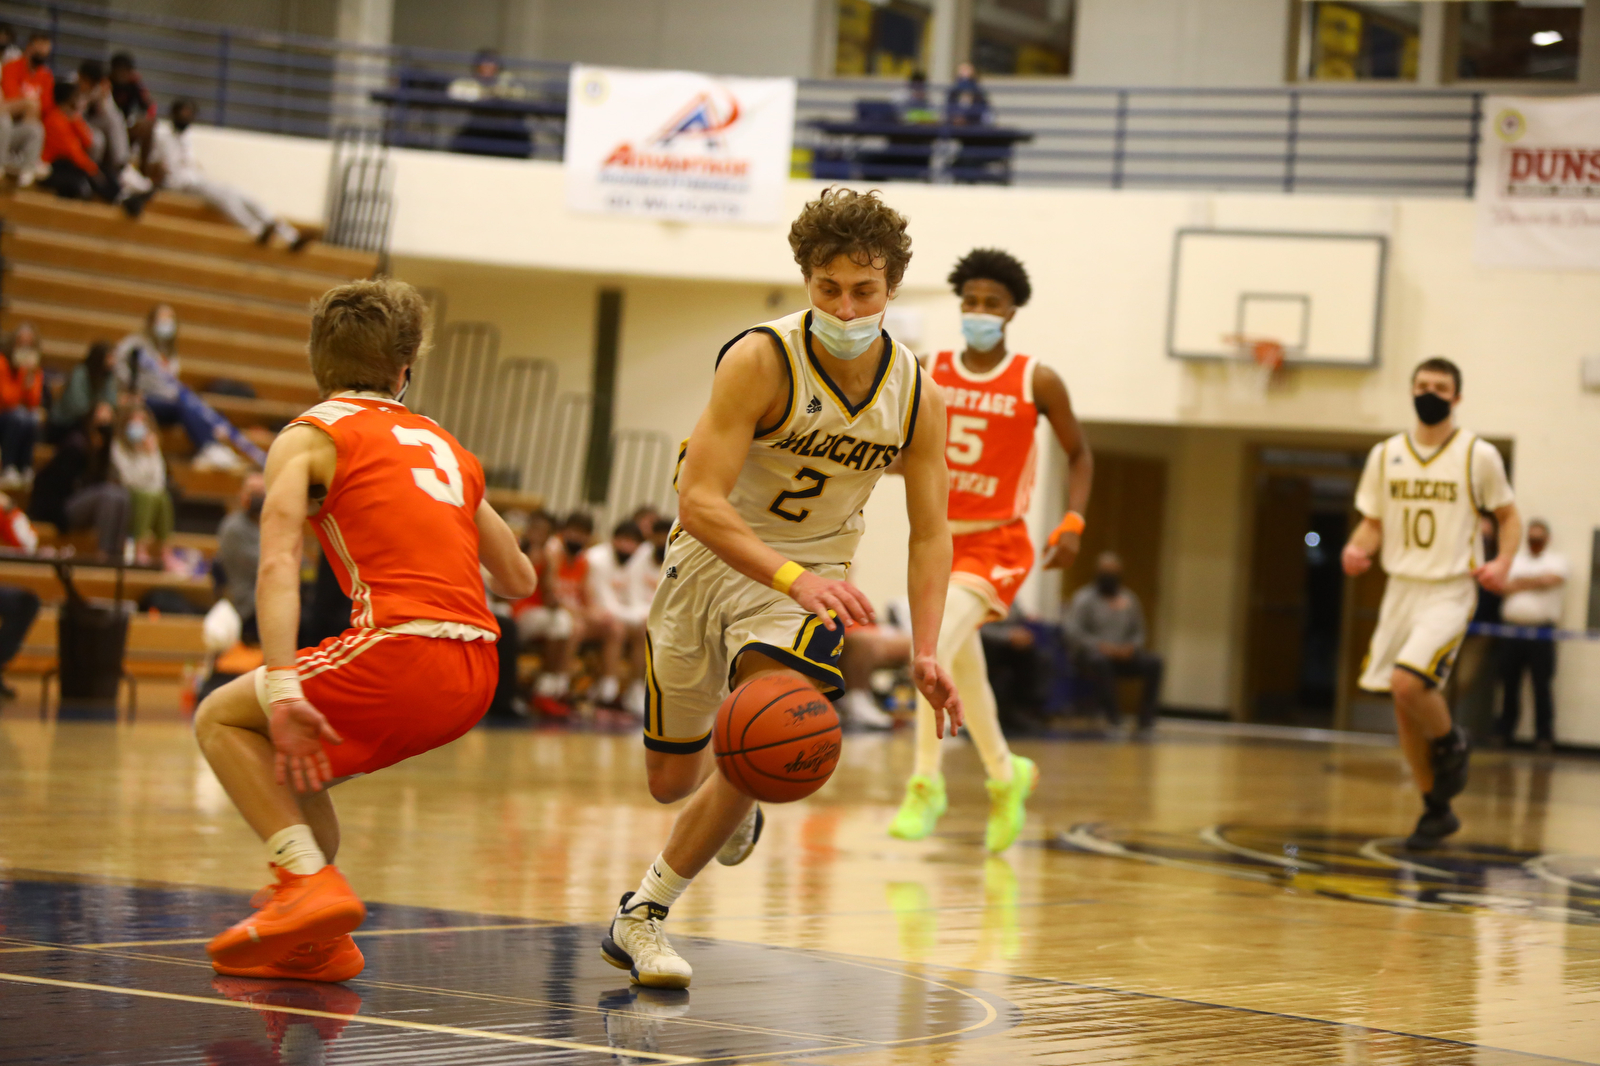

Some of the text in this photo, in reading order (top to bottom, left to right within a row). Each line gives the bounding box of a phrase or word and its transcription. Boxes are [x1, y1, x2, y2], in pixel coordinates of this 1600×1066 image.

[941, 385, 1018, 418] ORTAGE
[391, 424, 465, 508] 3
[770, 429, 899, 471] WILDCATS
[767, 466, 834, 523] 2
[1390, 479, 1458, 502] WILDCATS
[1403, 507, 1436, 549] 10
